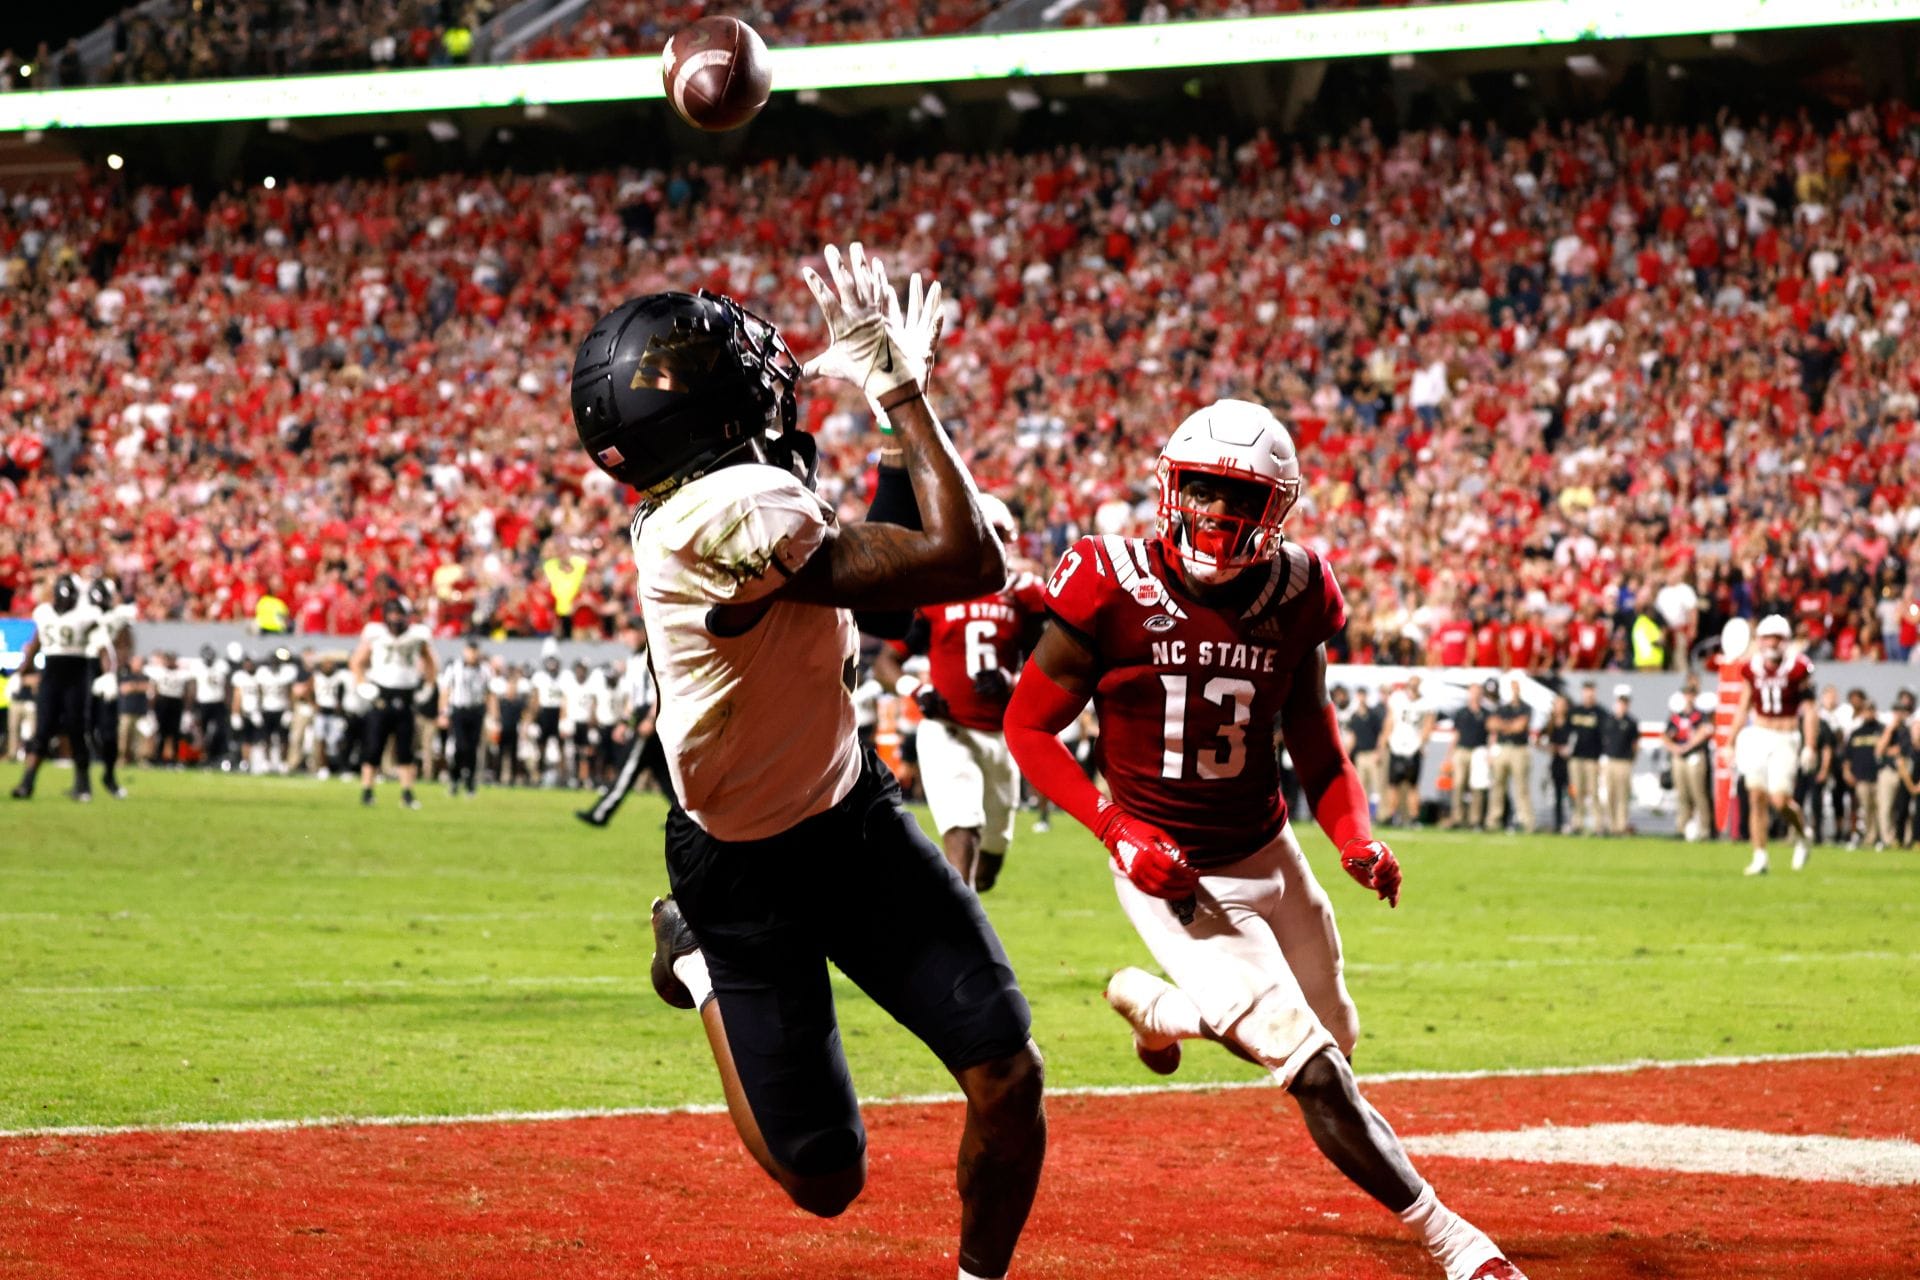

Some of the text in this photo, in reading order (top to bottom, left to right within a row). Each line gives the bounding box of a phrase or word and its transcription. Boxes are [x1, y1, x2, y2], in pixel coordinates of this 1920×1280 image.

[1137, 591, 1158, 599] UNITED
[965, 620, 998, 680] 6
[1151, 640, 1278, 673] NC STATE
[1760, 684, 1783, 714] 11
[1159, 673, 1256, 780] 13
